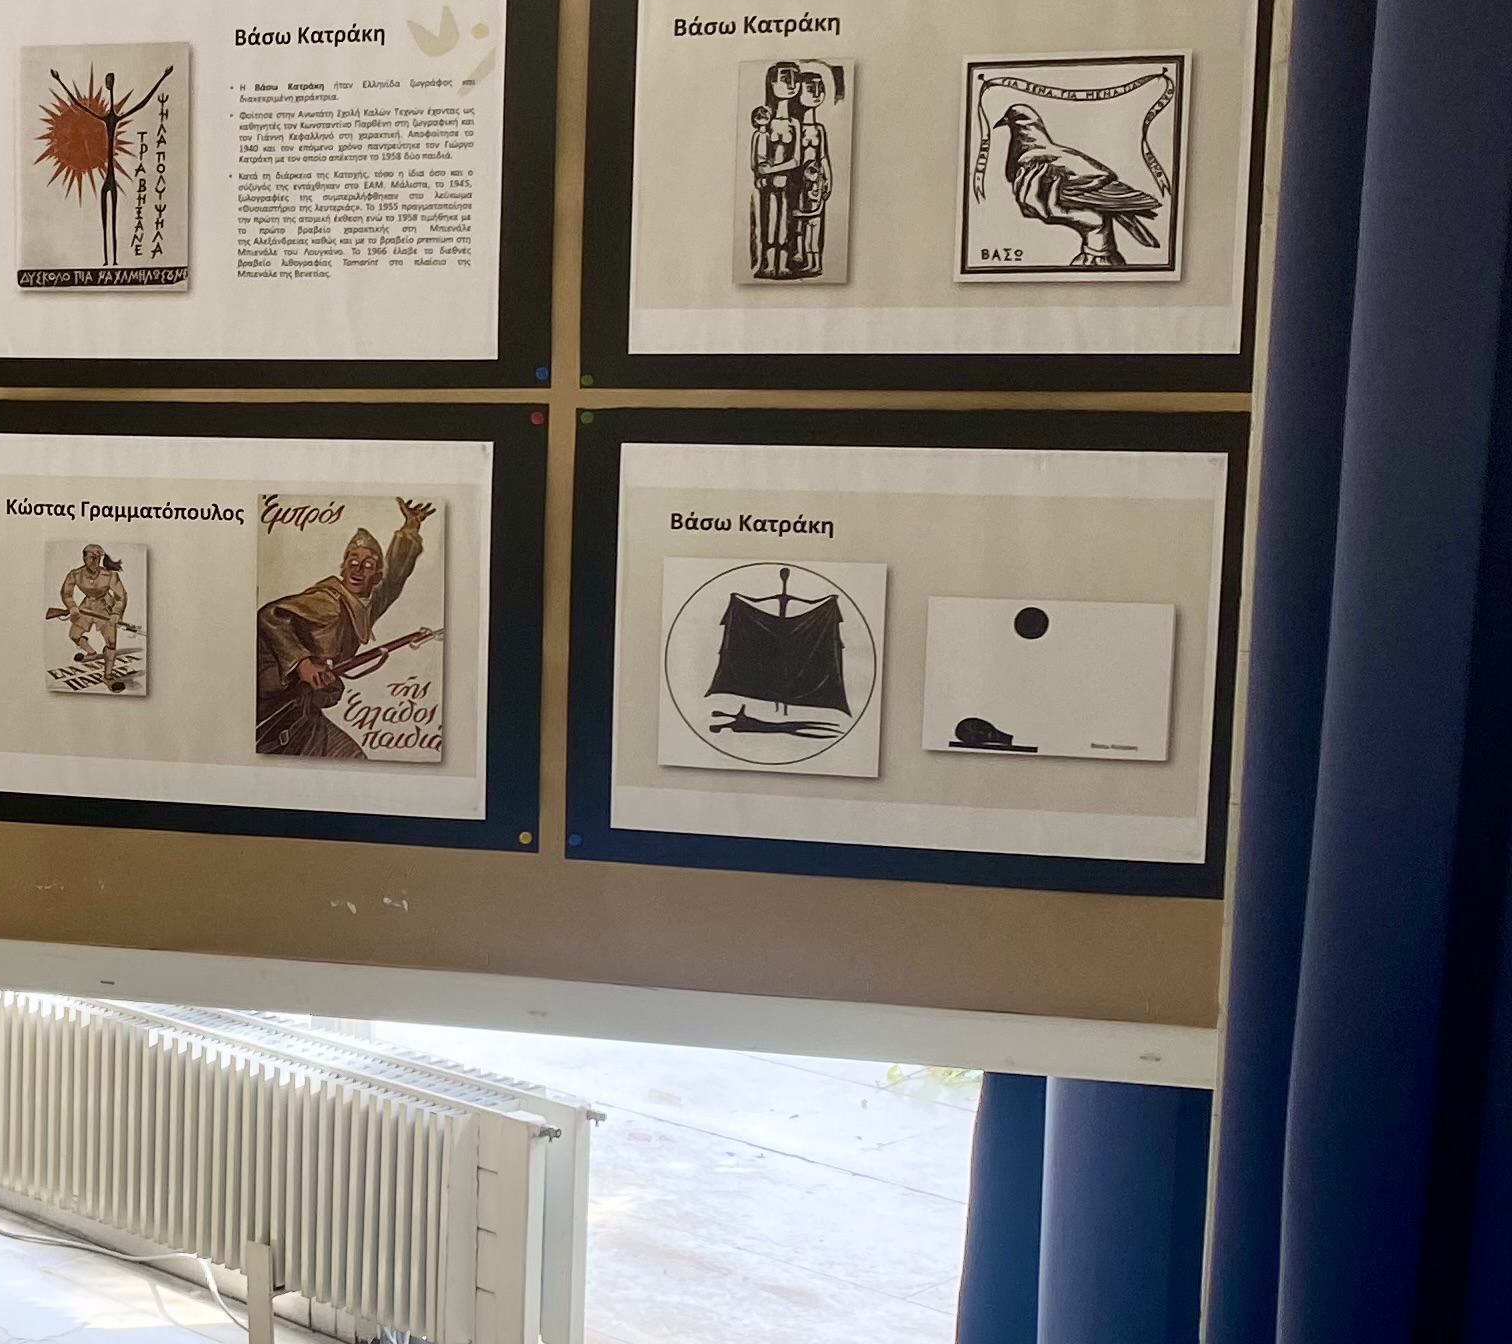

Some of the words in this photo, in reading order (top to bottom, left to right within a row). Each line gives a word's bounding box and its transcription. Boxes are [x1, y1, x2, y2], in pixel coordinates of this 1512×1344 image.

[234, 25, 291, 46] Βάσω
[297, 22, 384, 47] Κατράκη
[673, 15, 736, 36] Βάσω
[743, 11, 840, 37] Κατράκη
[981, 248, 1024, 262] ΒΑΣΩ
[6, 496, 75, 520] Κώστας
[80, 495, 244, 526] Γραμματόπουλος
[670, 511, 731, 531] Βάσω
[738, 513, 834, 538] Κατράκη
